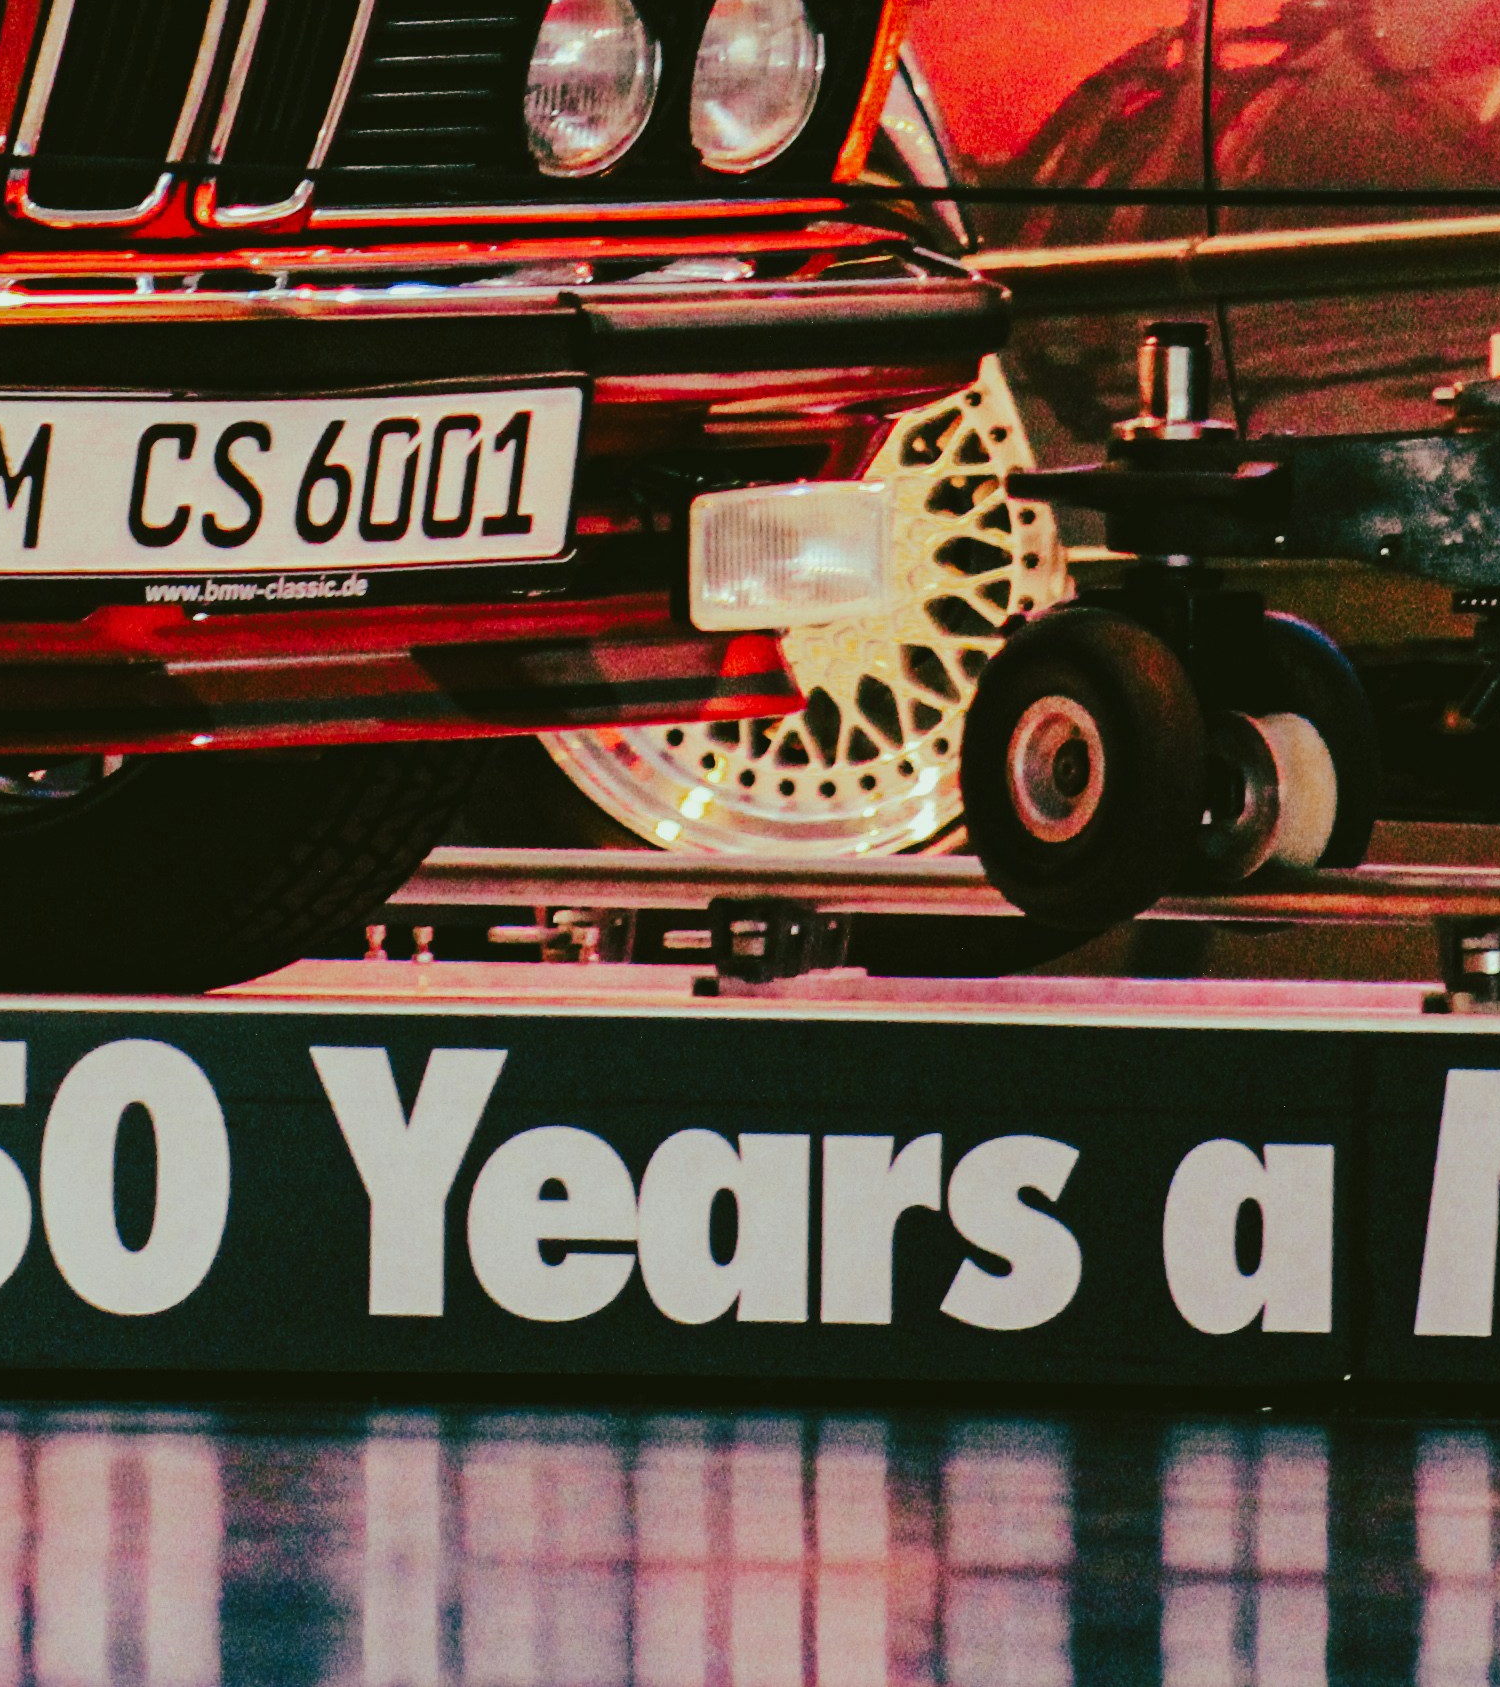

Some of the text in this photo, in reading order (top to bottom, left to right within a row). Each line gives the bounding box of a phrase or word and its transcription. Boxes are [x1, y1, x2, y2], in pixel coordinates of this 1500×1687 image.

[127, 420, 272, 549] CS
[294, 410, 533, 545] 6001
[144, 574, 369, 604] www.bmw-classic.de
[309, 1045, 1082, 1334] Years
[1162, 1138, 1335, 1335] a
